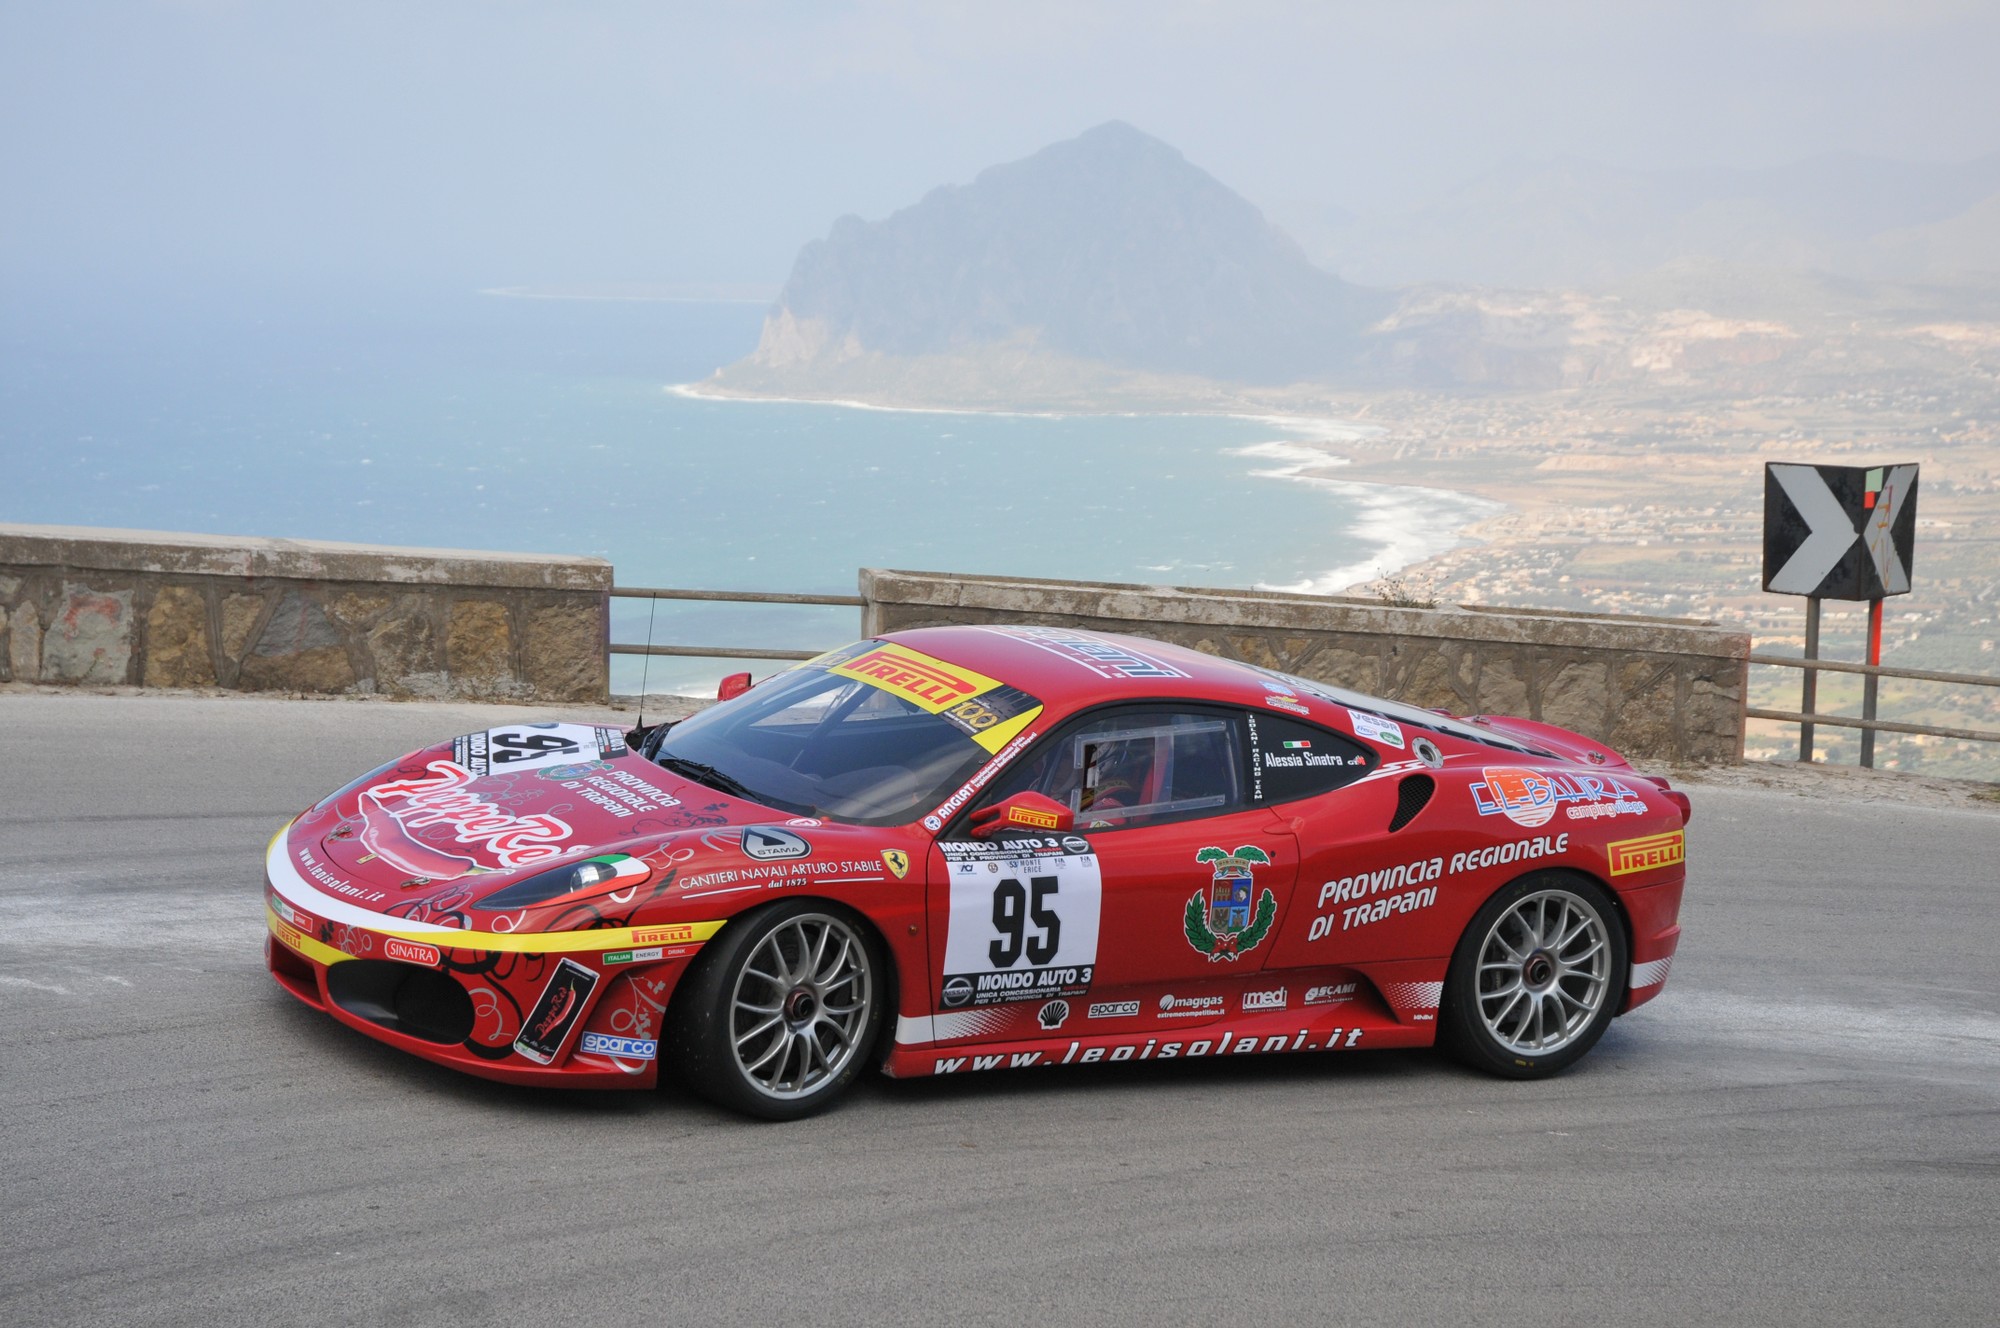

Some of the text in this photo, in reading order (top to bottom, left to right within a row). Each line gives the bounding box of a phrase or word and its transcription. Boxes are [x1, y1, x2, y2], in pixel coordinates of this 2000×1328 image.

[842, 651, 977, 705] PIRELLI
[951, 701, 998, 728] 100
[492, 733, 579, 763] 95
[1249, 714, 1262, 800] ISOLANI RACING TEAM
[1265, 751, 1343, 767] Alessia Sinatra
[560, 780, 634, 818] DI TRAPANI
[584, 775, 659, 812] REGIONALE
[606, 770, 682, 807] PROVINCIA
[937, 784, 975, 819] ANGLAT
[1011, 809, 1056, 827] PIRELLI
[757, 847, 801, 856] STAMA
[938, 837, 1059, 853] MONDO AUTO 3
[1610, 834, 1682, 872] PIRELLI
[1020, 858, 1042, 867] MONTE
[1023, 866, 1042, 874] ERICE
[1317, 833, 1569, 909] PROVINCIA REGIONALE
[299, 847, 386, 902] www.leoisolani.it
[679, 859, 883, 890] CANTIERI NAVALI ARTURO STABILE
[768, 877, 807, 889] dal 1875
[989, 876, 1061, 968] 95
[1308, 886, 1437, 942] DI TRAPANI
[277, 919, 302, 949] PIRELLI
[631, 925, 692, 943] PIRELLI
[390, 943, 434, 962] SINATRA
[607, 953, 631, 962] ITALIAN
[635, 950, 660, 959] ENERGY
[977, 967, 1092, 991] MONDO AUTO 3
[943, 988, 973, 997] NISSAN
[976, 991, 998, 999] UNICA
[999, 986, 1061, 997] CONCESSIONARIA
[1174, 996, 1224, 1008] magigas
[1247, 986, 1285, 1005] med
[1090, 1002, 1138, 1016] sparco
[1157, 1008, 1225, 1019] extremecompetition.it
[584, 1035, 655, 1055] sparco
[934, 1028, 1364, 1075] www.leoisolani.it
